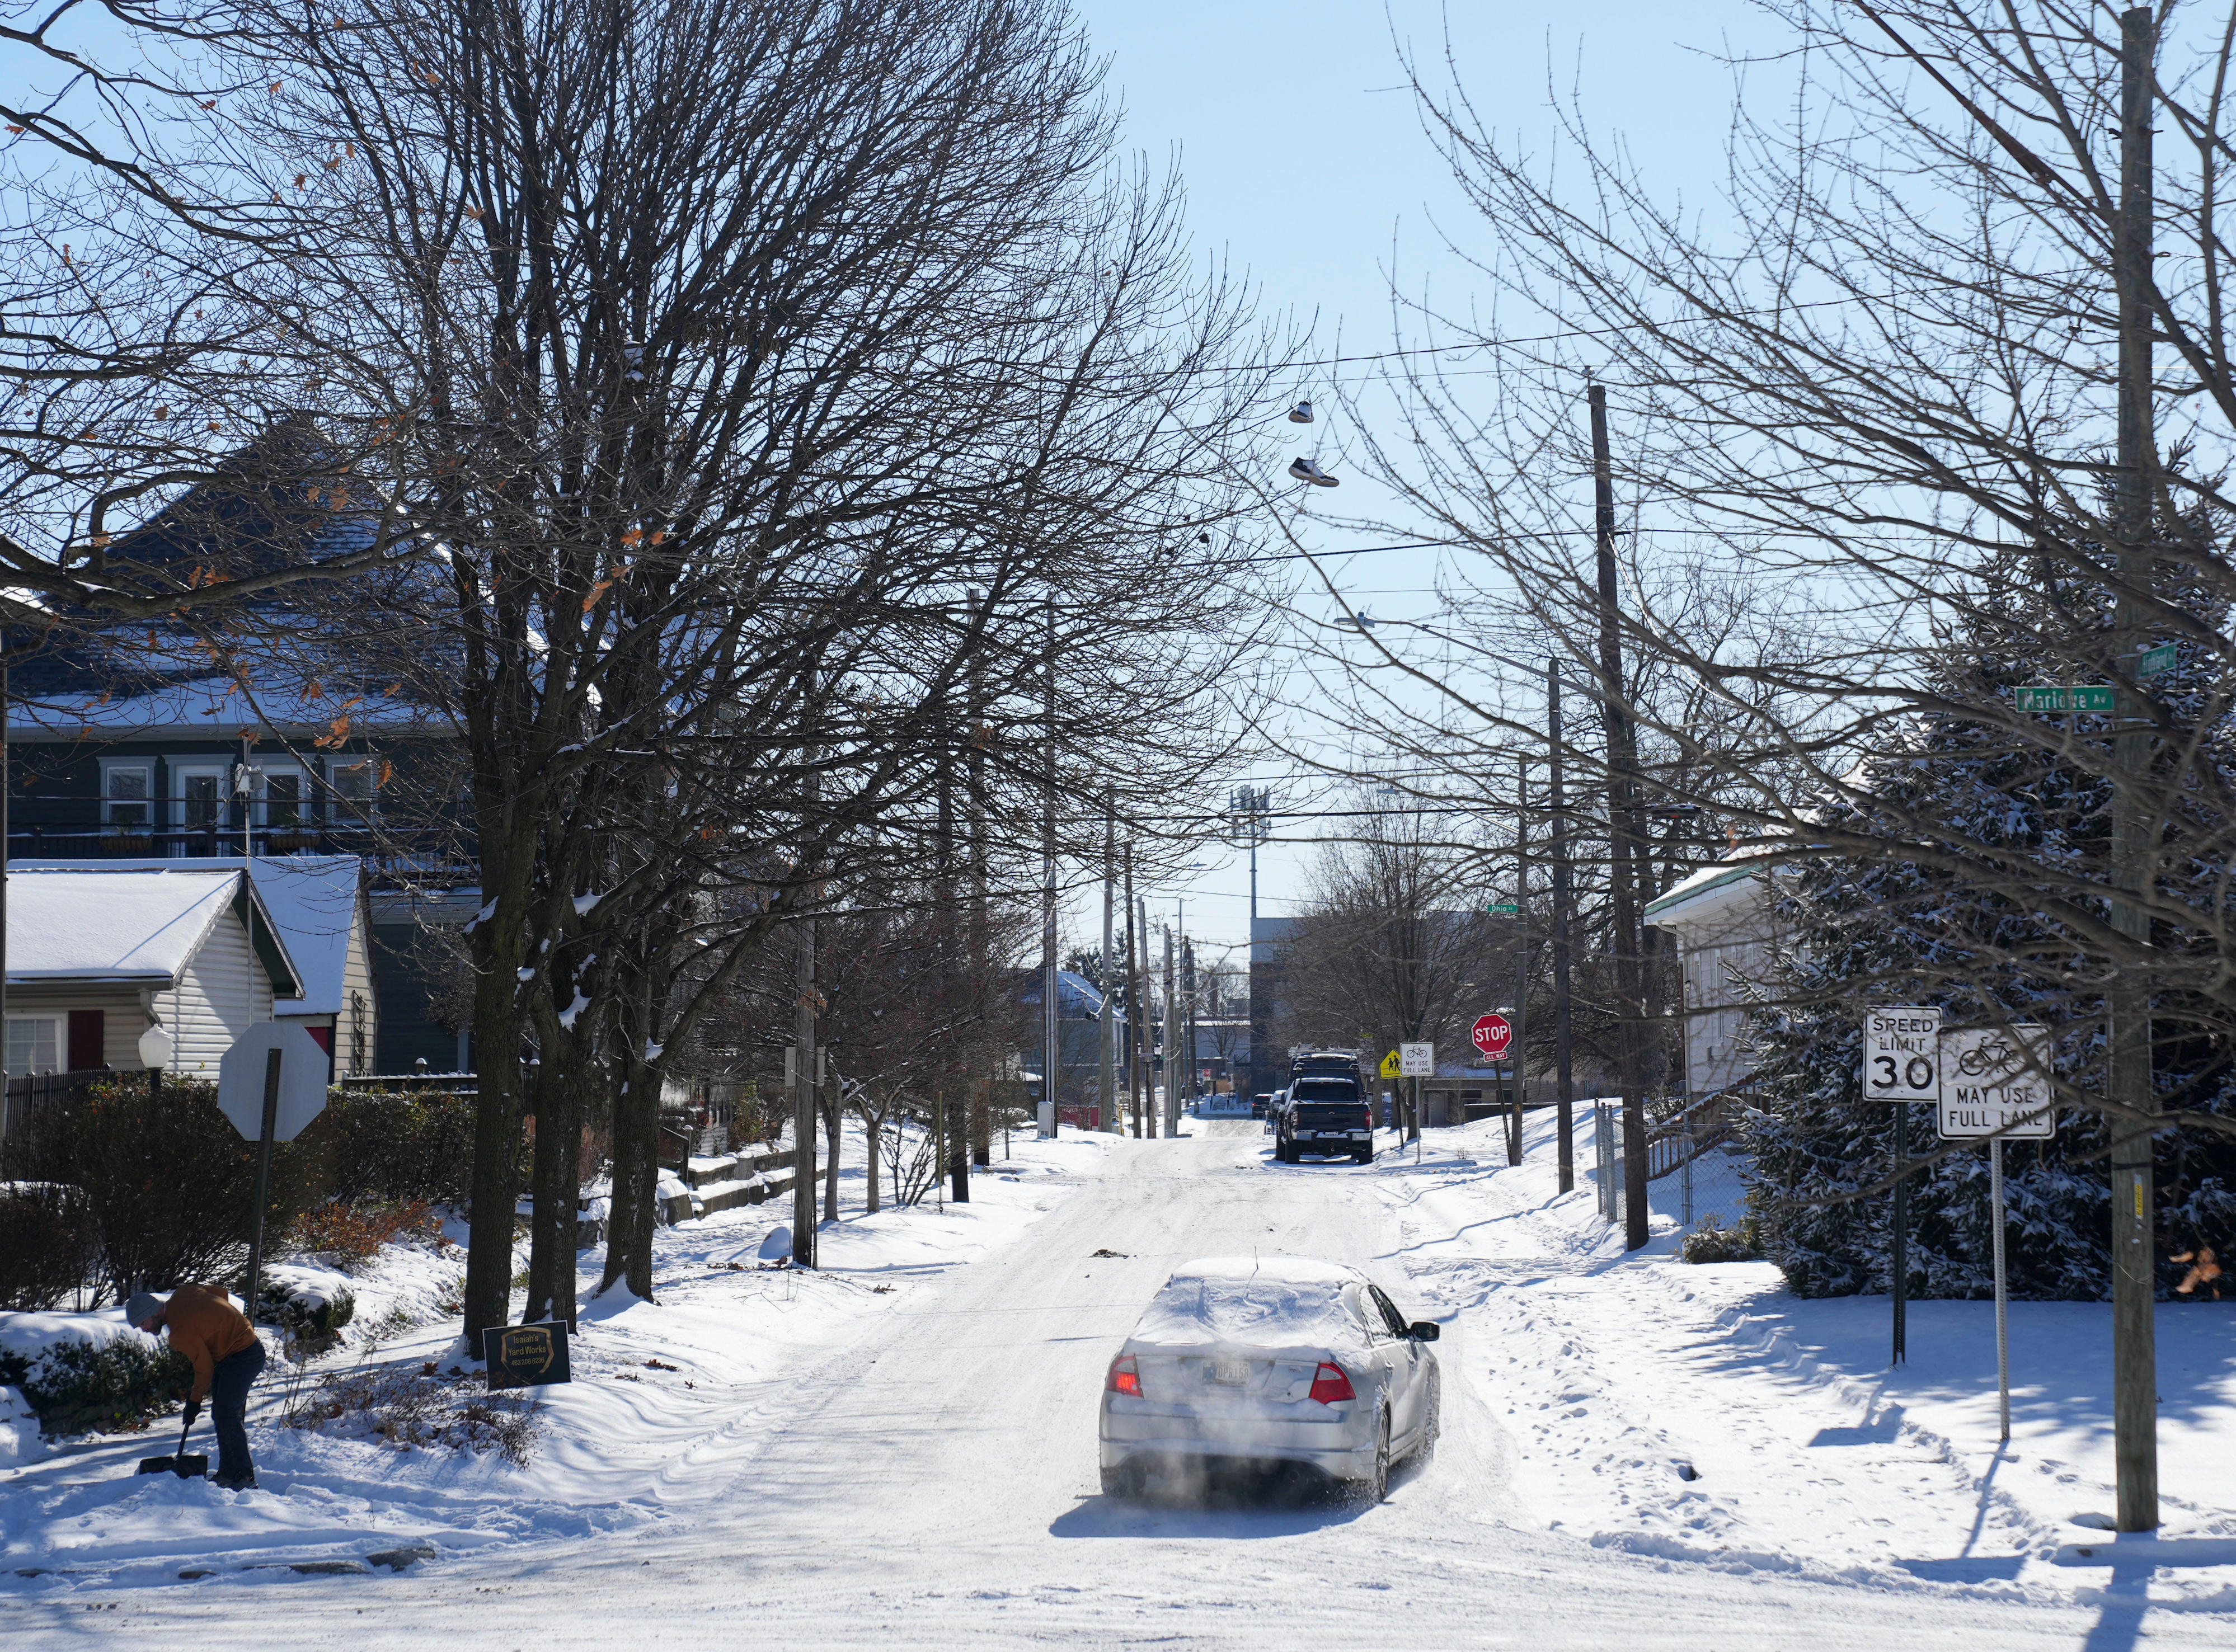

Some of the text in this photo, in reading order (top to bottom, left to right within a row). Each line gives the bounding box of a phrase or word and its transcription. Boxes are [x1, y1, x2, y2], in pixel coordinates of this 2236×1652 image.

[2024, 691, 2106, 709] Marlowe Av
[1873, 1018, 1933, 1032] SPEED
[1475, 1025, 1507, 1042] STOP
[1880, 1037, 1925, 1051] LIMIT
[1871, 1056, 1933, 1090] 30
[1957, 1087, 2033, 1103] MAY USE
[1950, 1111, 1991, 1127] FULL
[514, 1334, 539, 1344] Isaiah's
[508, 1345, 547, 1356] Yard Works
